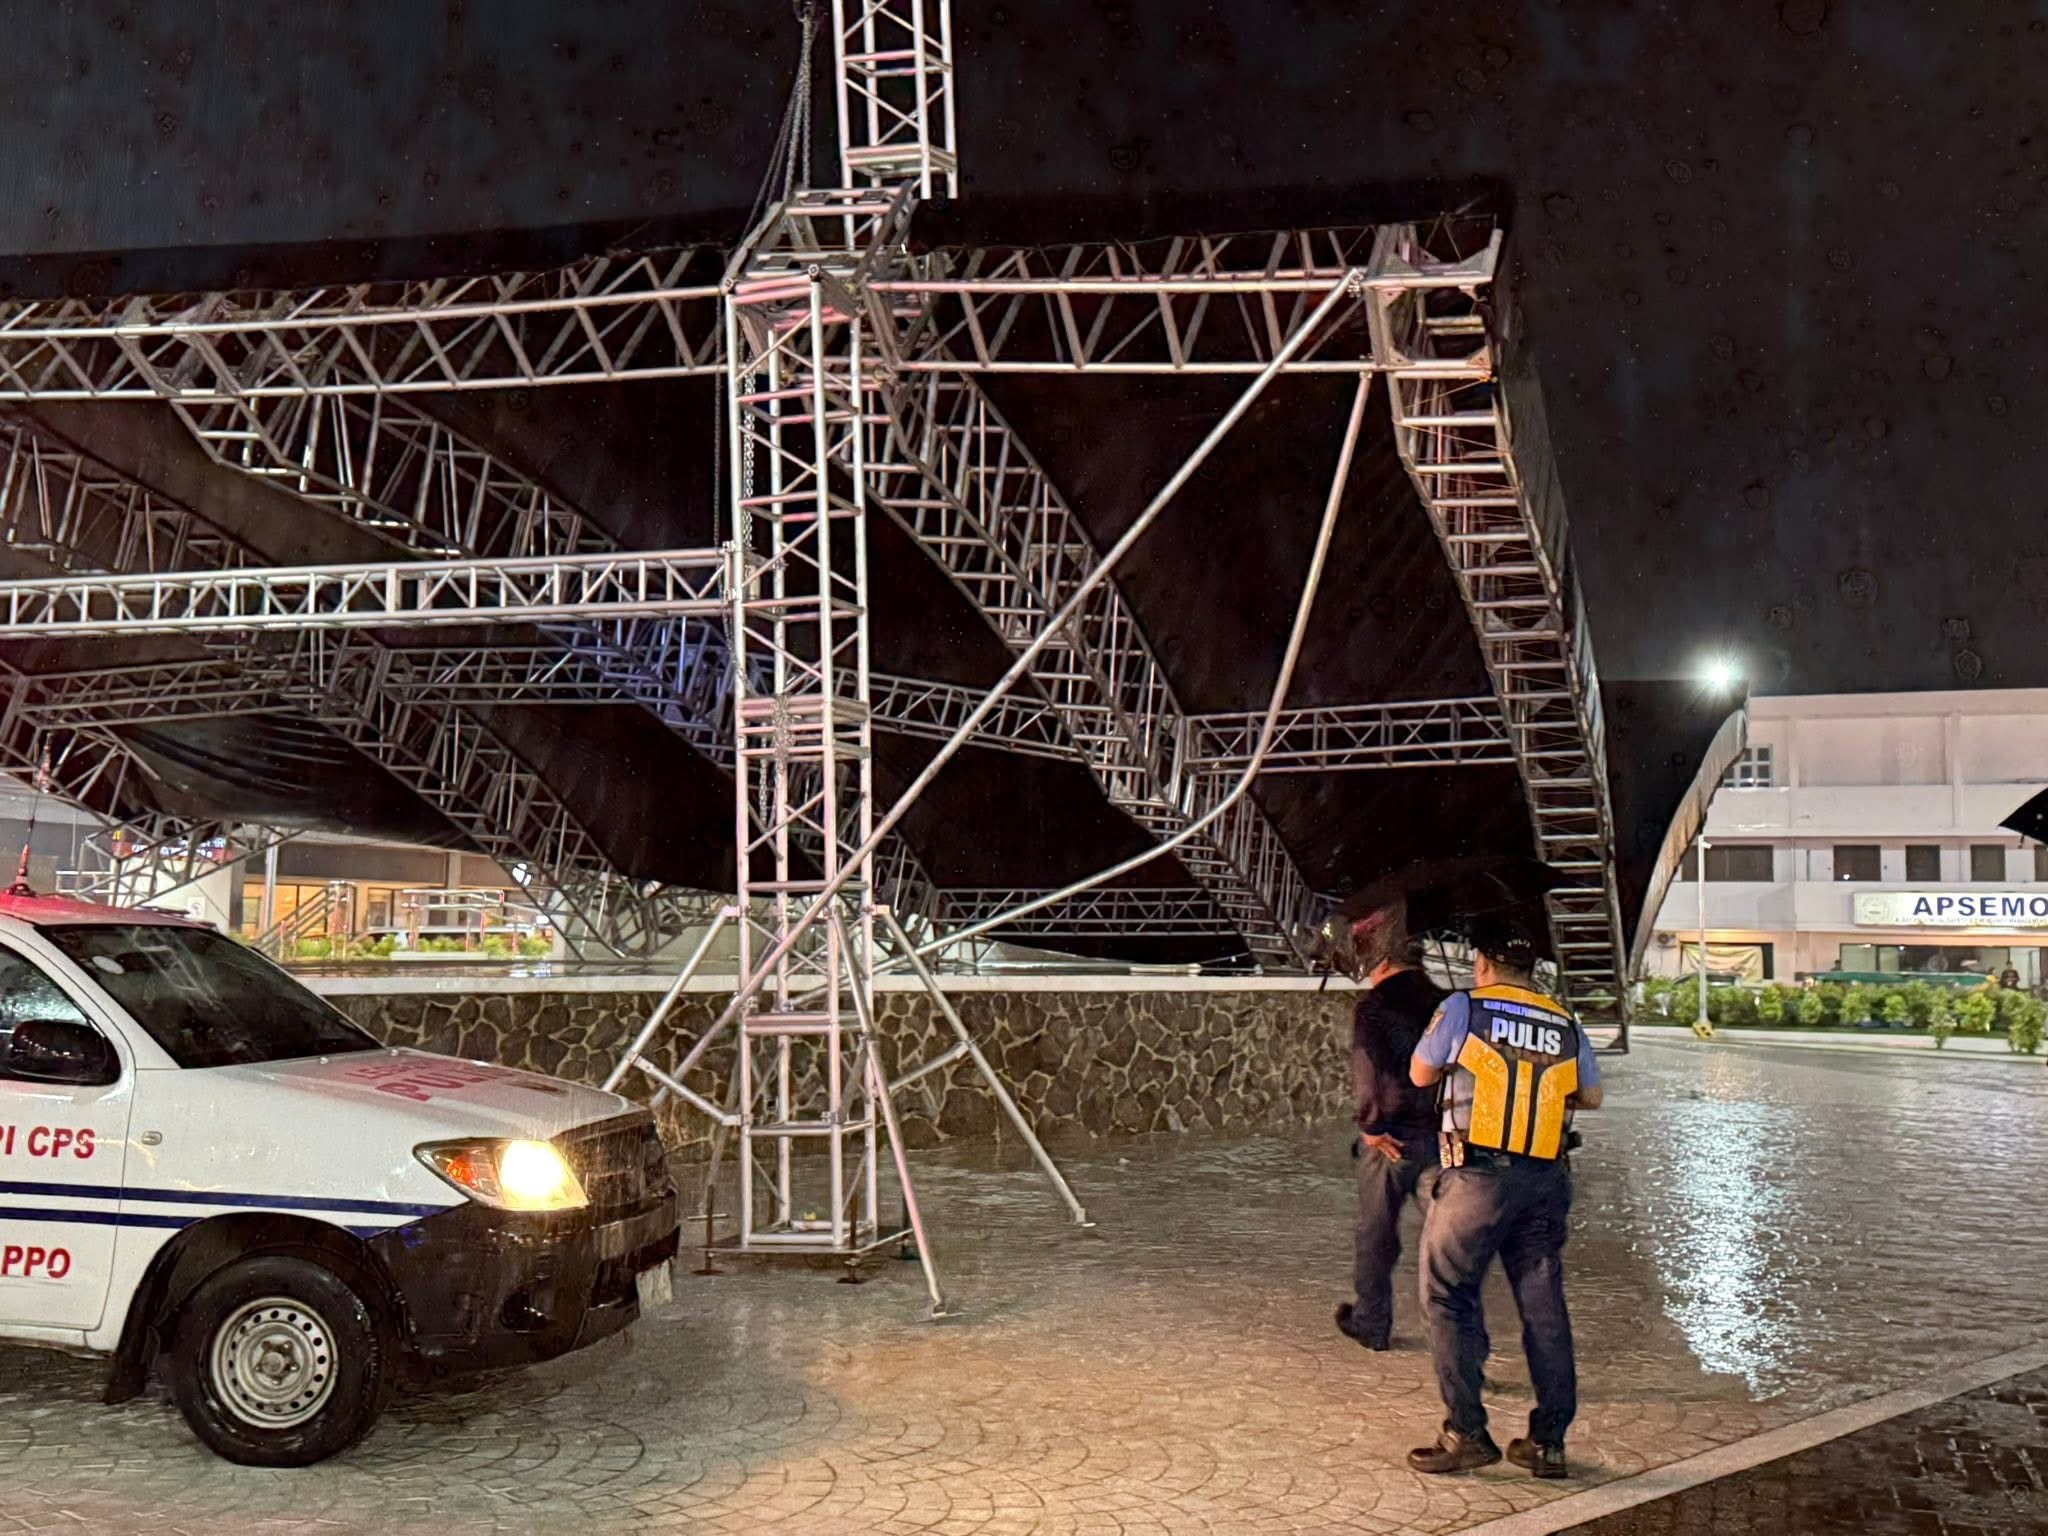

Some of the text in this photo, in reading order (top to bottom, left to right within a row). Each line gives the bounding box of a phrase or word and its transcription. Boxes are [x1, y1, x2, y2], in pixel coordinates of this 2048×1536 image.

[1913, 896, 2048, 916] APSEMO
[1491, 1016, 1561, 1056] PULIS
[27, 1126, 96, 1159] CPS
[1, 1245, 71, 1278] PPO
